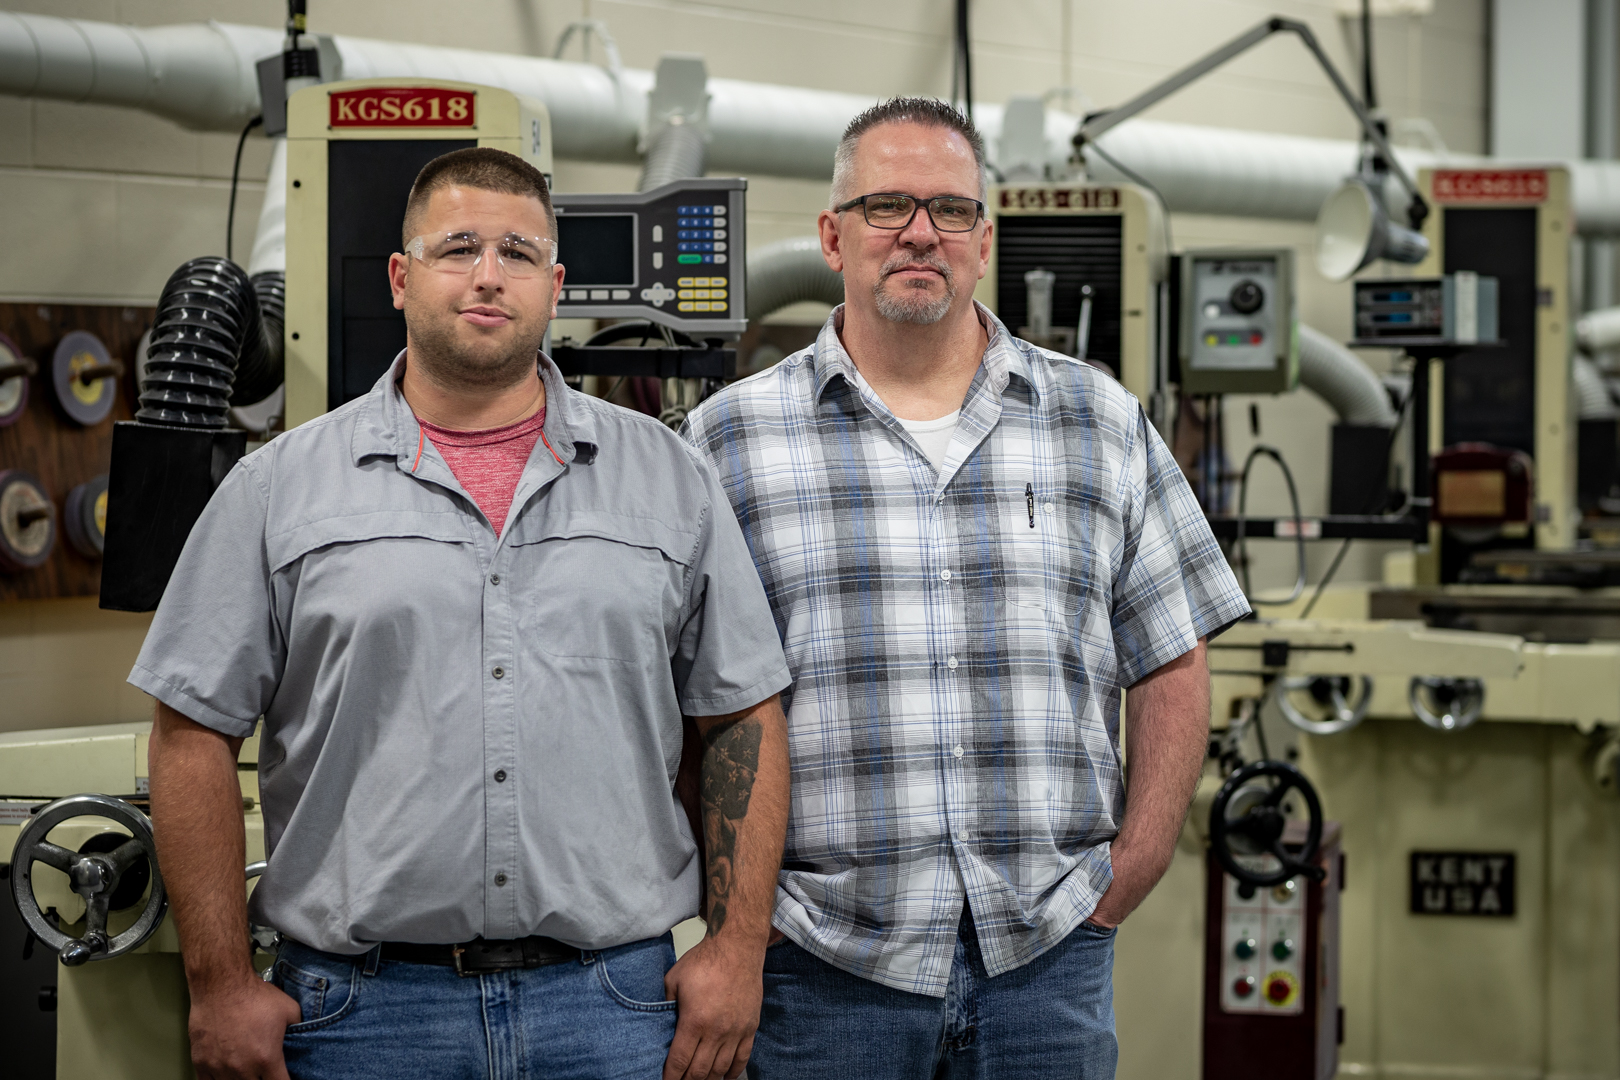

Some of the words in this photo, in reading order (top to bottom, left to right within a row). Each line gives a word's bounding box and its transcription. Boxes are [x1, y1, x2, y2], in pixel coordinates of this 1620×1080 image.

[337, 97, 469, 121] KGS618
[1418, 858, 1506, 882] KENT
[1423, 887, 1501, 911] USA
